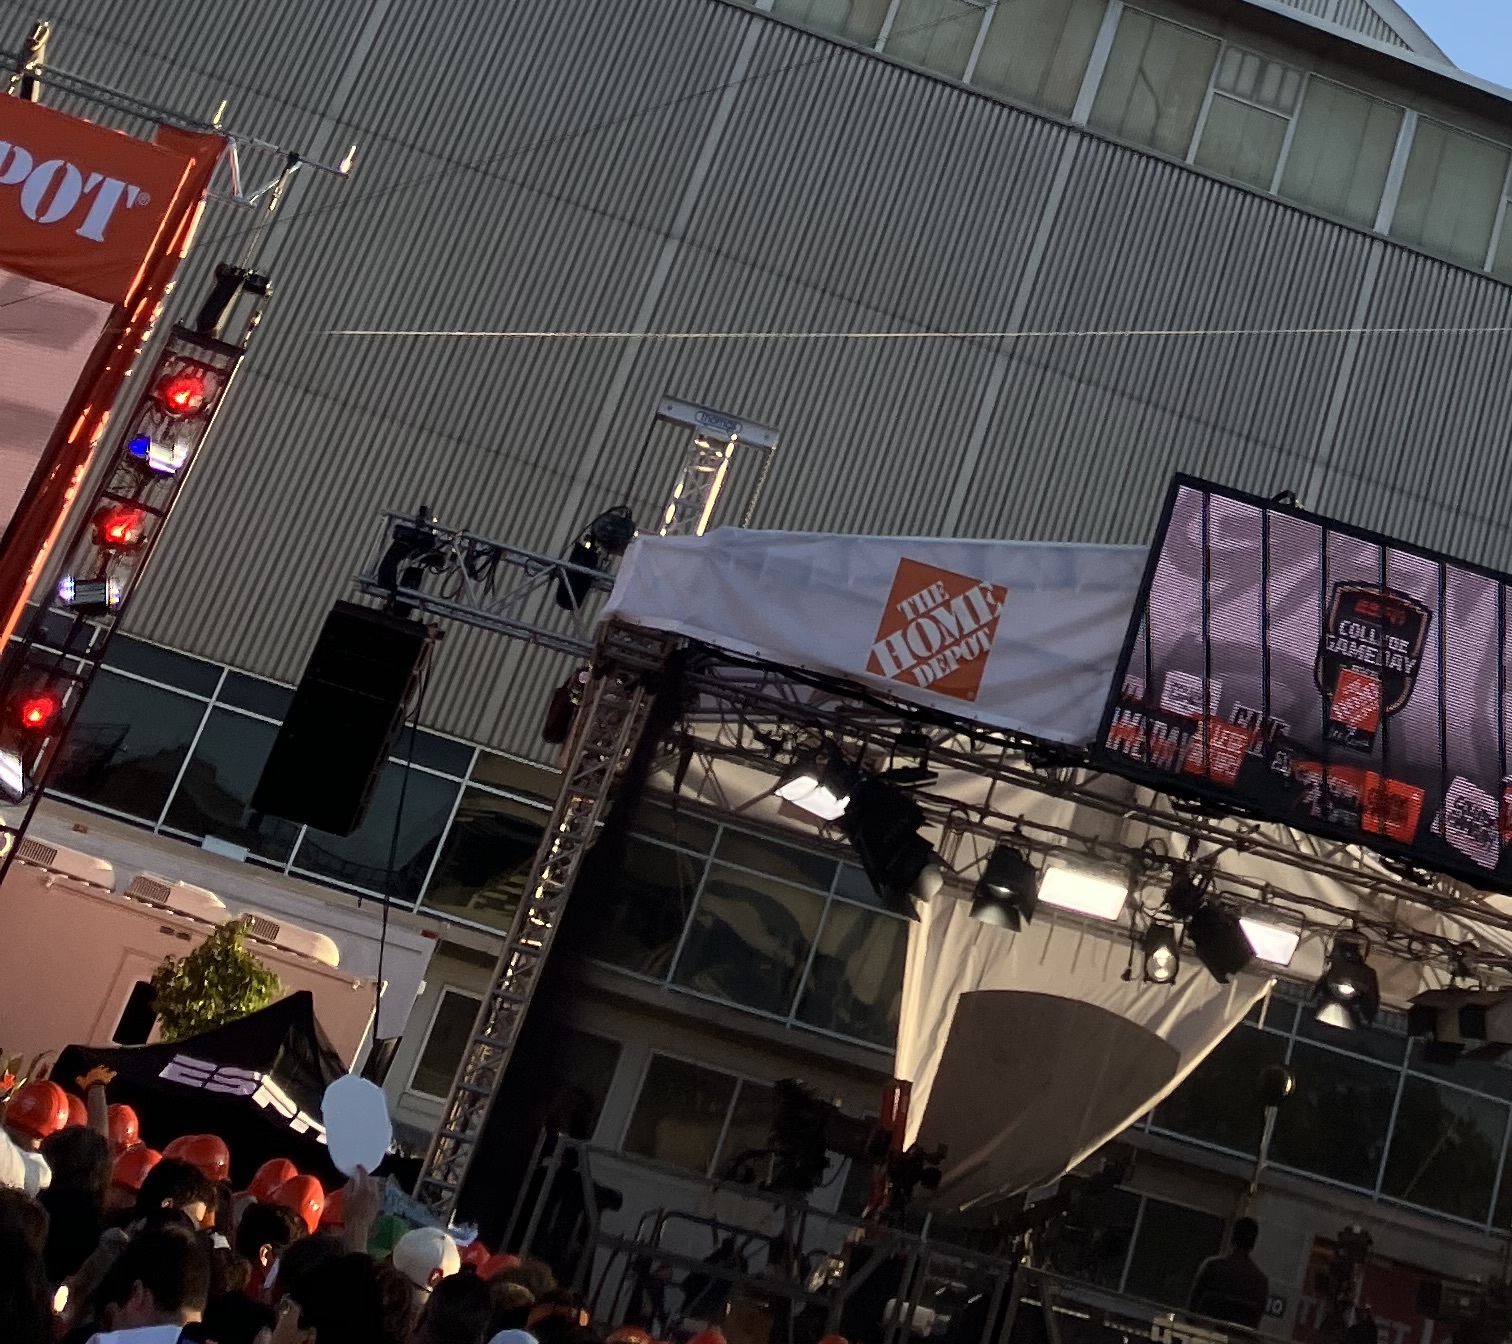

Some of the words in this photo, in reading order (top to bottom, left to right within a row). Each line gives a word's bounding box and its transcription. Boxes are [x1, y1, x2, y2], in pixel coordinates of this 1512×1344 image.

[896, 580, 950, 622] THE
[872, 580, 1001, 678] HOME
[1338, 620, 1410, 654] COLLGE
[912, 627, 993, 688] DEPOT
